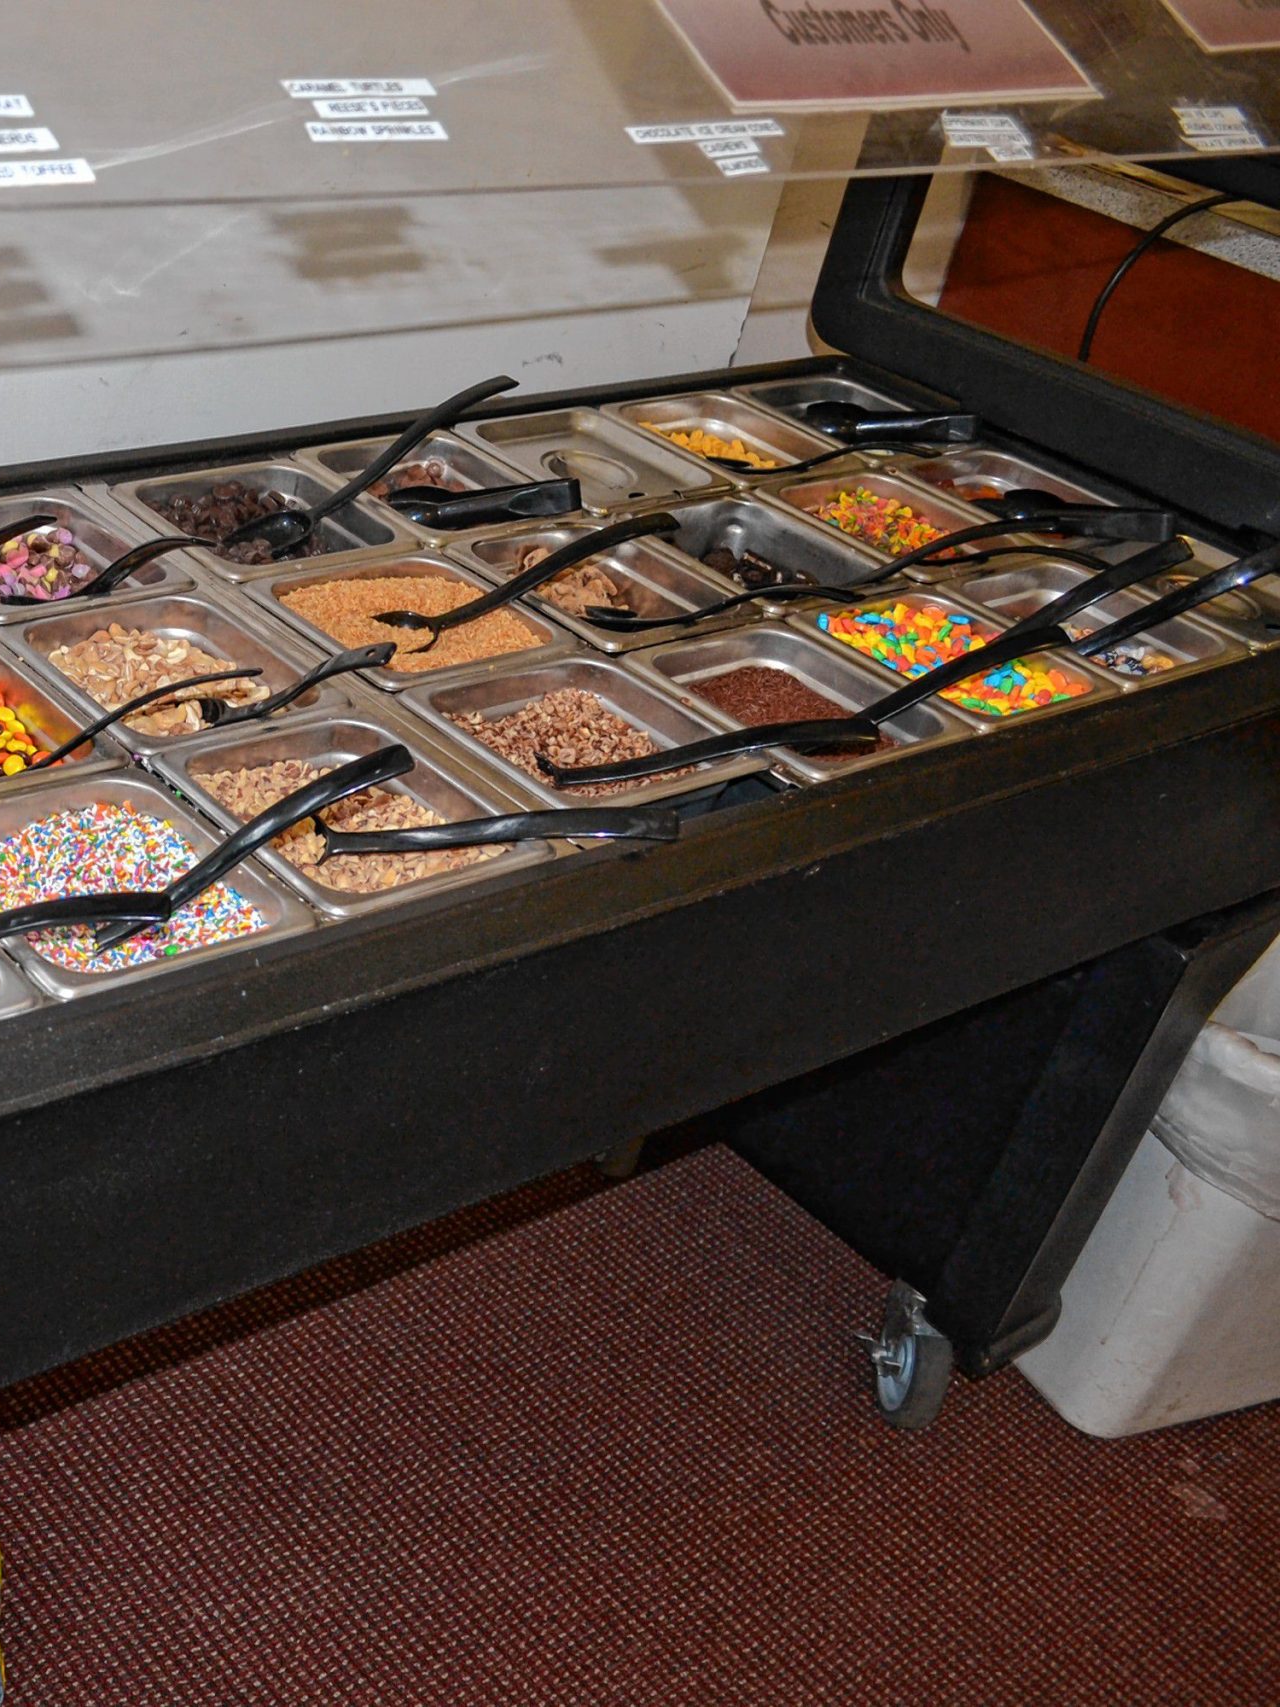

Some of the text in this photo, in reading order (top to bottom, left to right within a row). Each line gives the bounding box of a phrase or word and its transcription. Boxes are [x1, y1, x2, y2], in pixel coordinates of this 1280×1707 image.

[759, 0, 971, 53] Customers Only
[310, 124, 368, 136] RAINBOW
